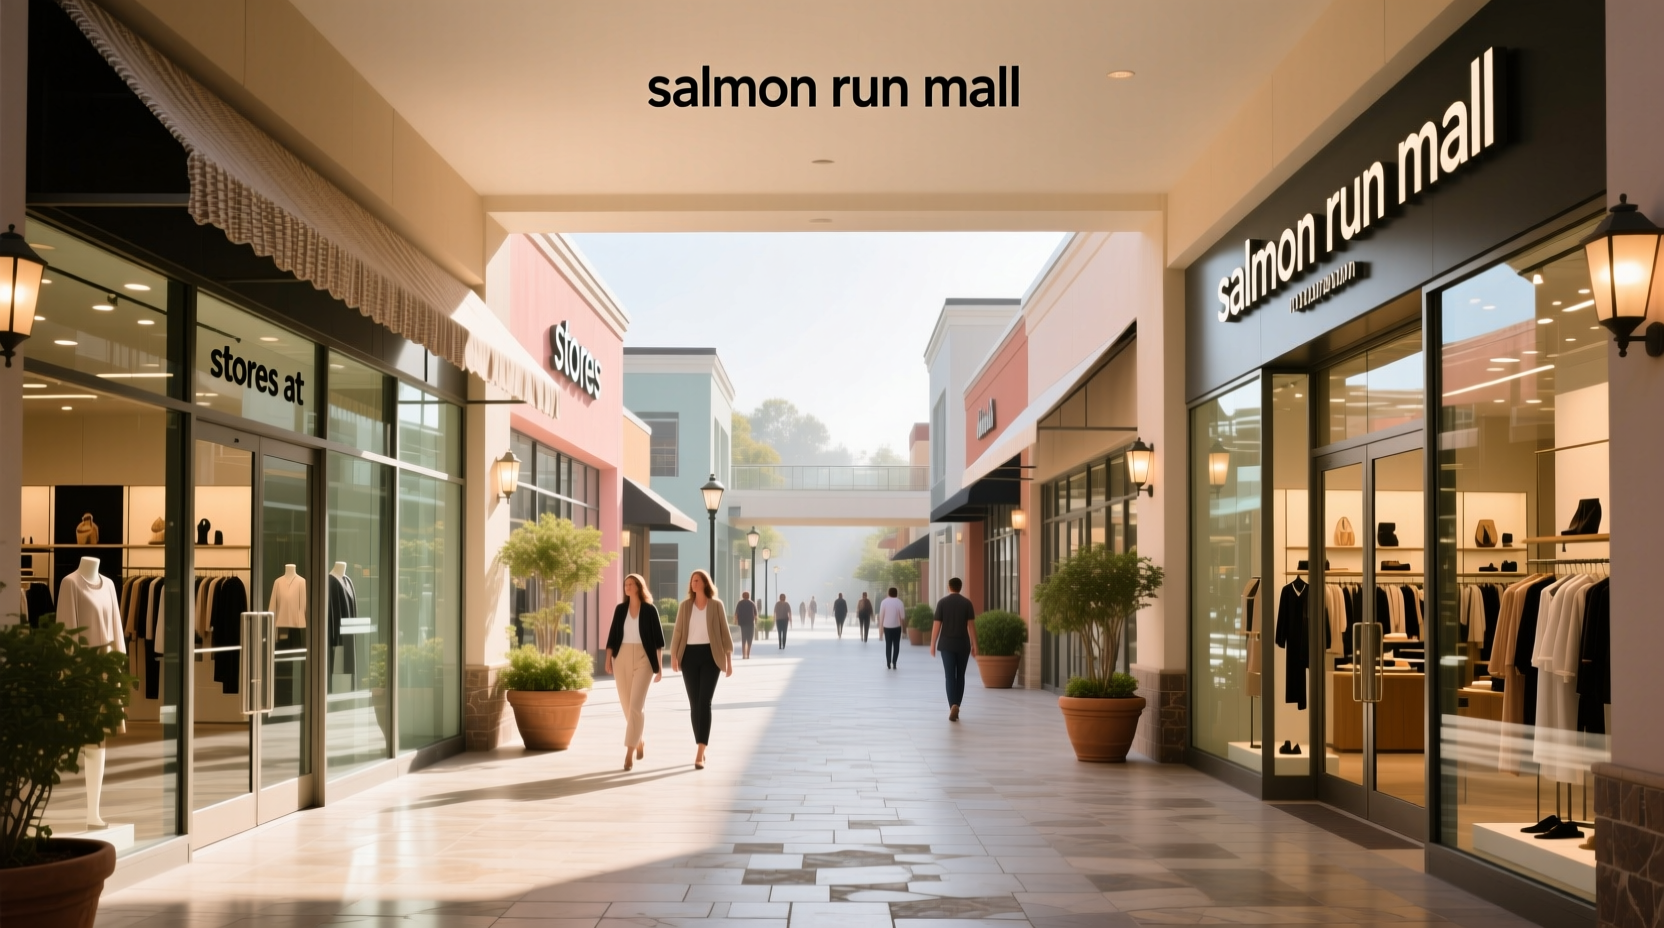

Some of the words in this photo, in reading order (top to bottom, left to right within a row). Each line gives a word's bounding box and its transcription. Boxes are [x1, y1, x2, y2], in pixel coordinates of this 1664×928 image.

[648, 65, 816, 107] salmon
[833, 76, 908, 107] run
[925, 65, 1019, 107] mall
[1217, 212, 1315, 323] salmon
[1326, 161, 1384, 252] run
[1398, 46, 1494, 205] mall
[210, 345, 279, 397] stores
[283, 371, 305, 406] at
[553, 319, 602, 400] stores
